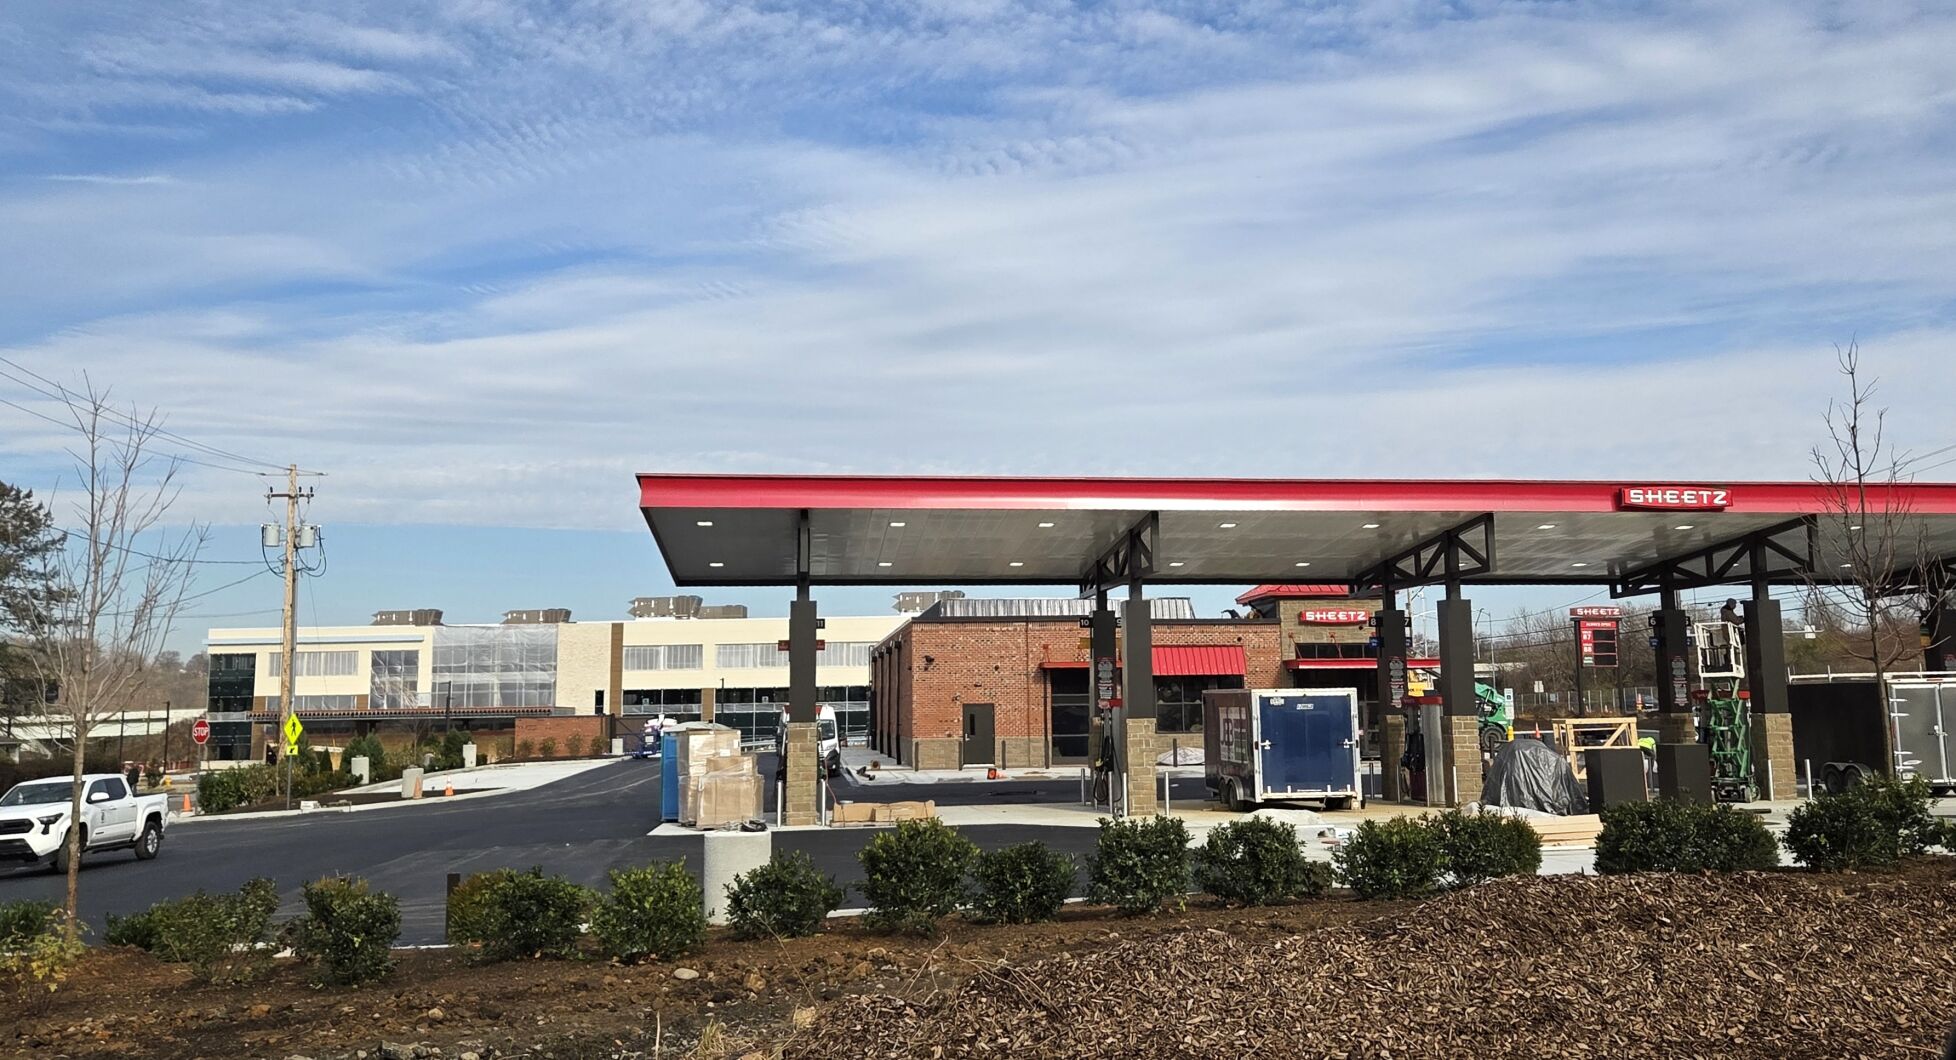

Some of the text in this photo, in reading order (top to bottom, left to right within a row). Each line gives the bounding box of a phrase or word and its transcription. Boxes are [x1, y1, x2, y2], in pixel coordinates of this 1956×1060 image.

[1629, 489, 1728, 505] SHEETZ
[1305, 611, 1366, 621] SHEETZ
[1576, 608, 1620, 616] SHEETZ
[1080, 619, 1090, 627] 10
[1370, 618, 1377, 626] 8
[1650, 617, 1657, 626] 6
[195, 727, 209, 736] STOP
